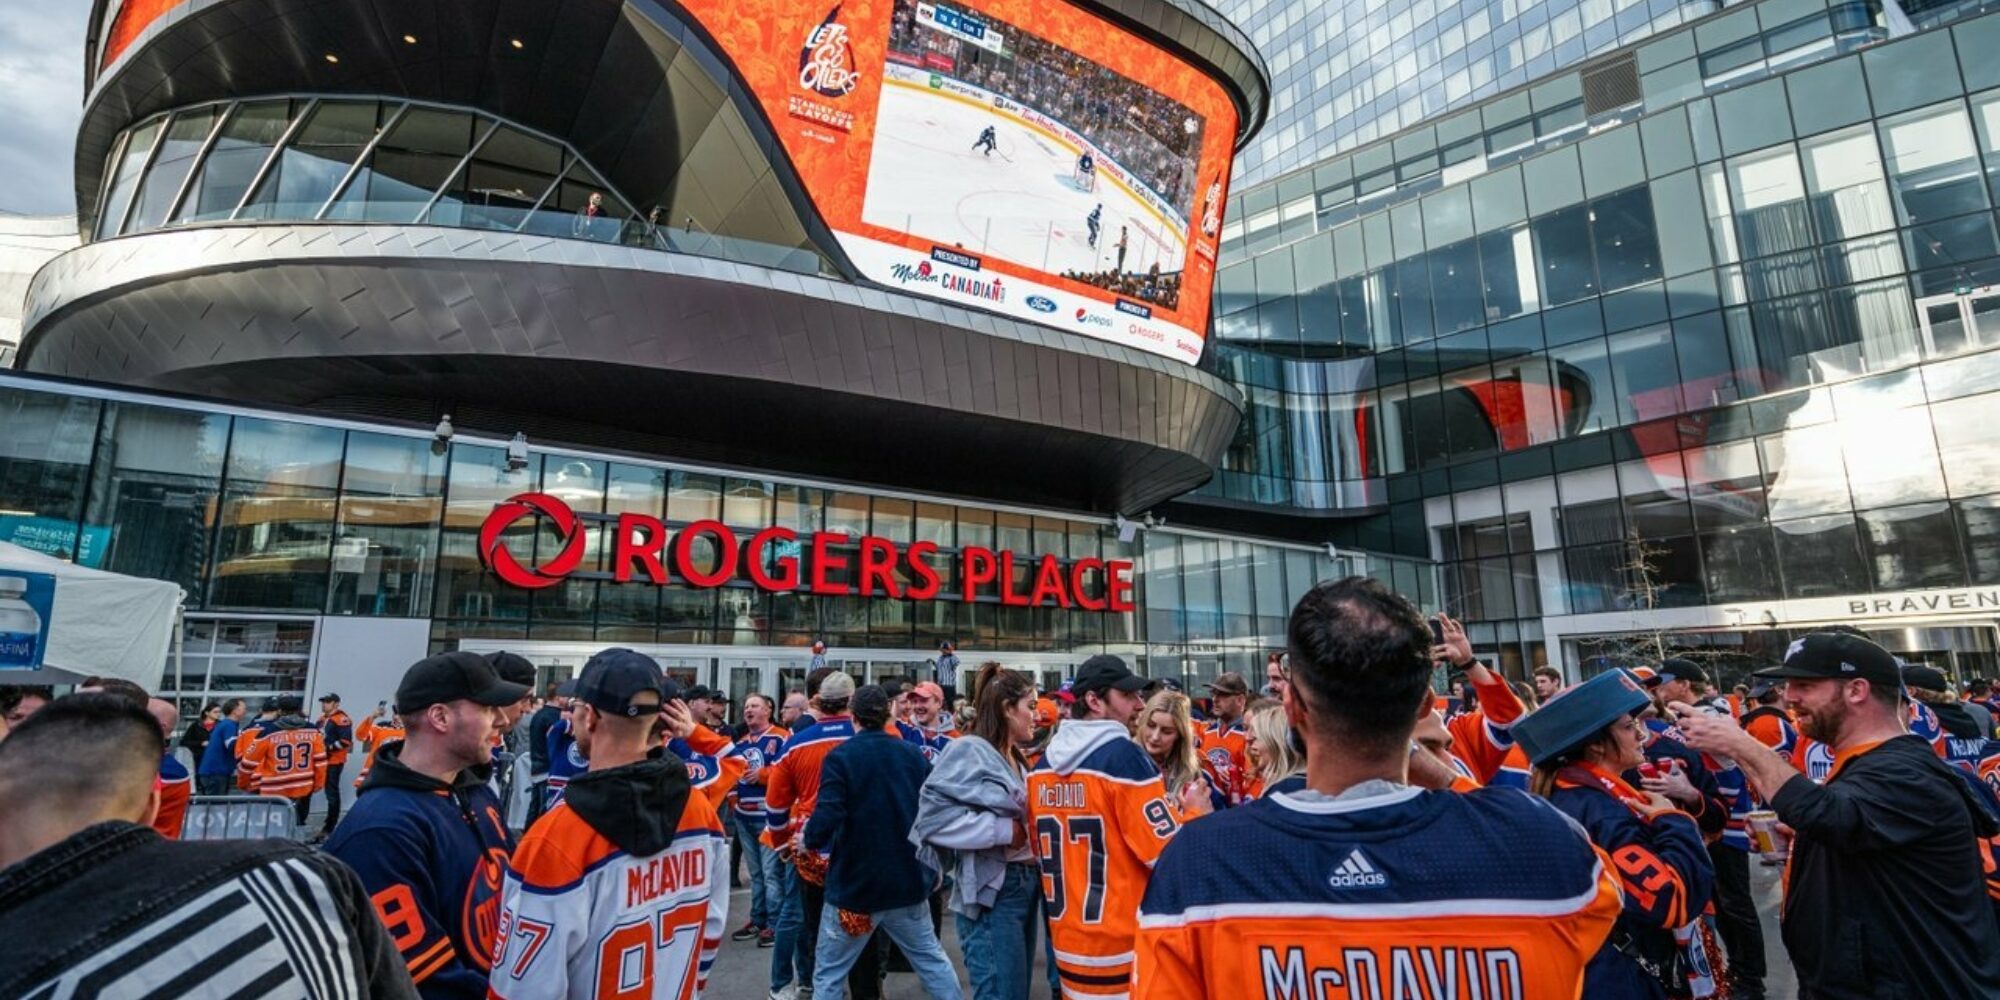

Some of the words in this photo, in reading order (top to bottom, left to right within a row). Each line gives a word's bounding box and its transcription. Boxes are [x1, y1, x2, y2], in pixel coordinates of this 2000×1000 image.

[891, 262, 938, 284] Molson
[941, 273, 999, 301] CANADIAN
[1029, 297, 1054, 311] Ford
[1088, 313, 1113, 328] pepsi
[613, 513, 941, 601] ROGERS
[961, 545, 1135, 612] PLACE
[275, 742, 312, 772] 93
[1037, 782, 1086, 808] McDAVID
[626, 848, 706, 908] McDAVID
[1036, 814, 1107, 924] 97
[1329, 872, 1386, 888] adidas
[592, 894, 710, 1000] 97
[1257, 944, 1525, 1000] McDAVID
